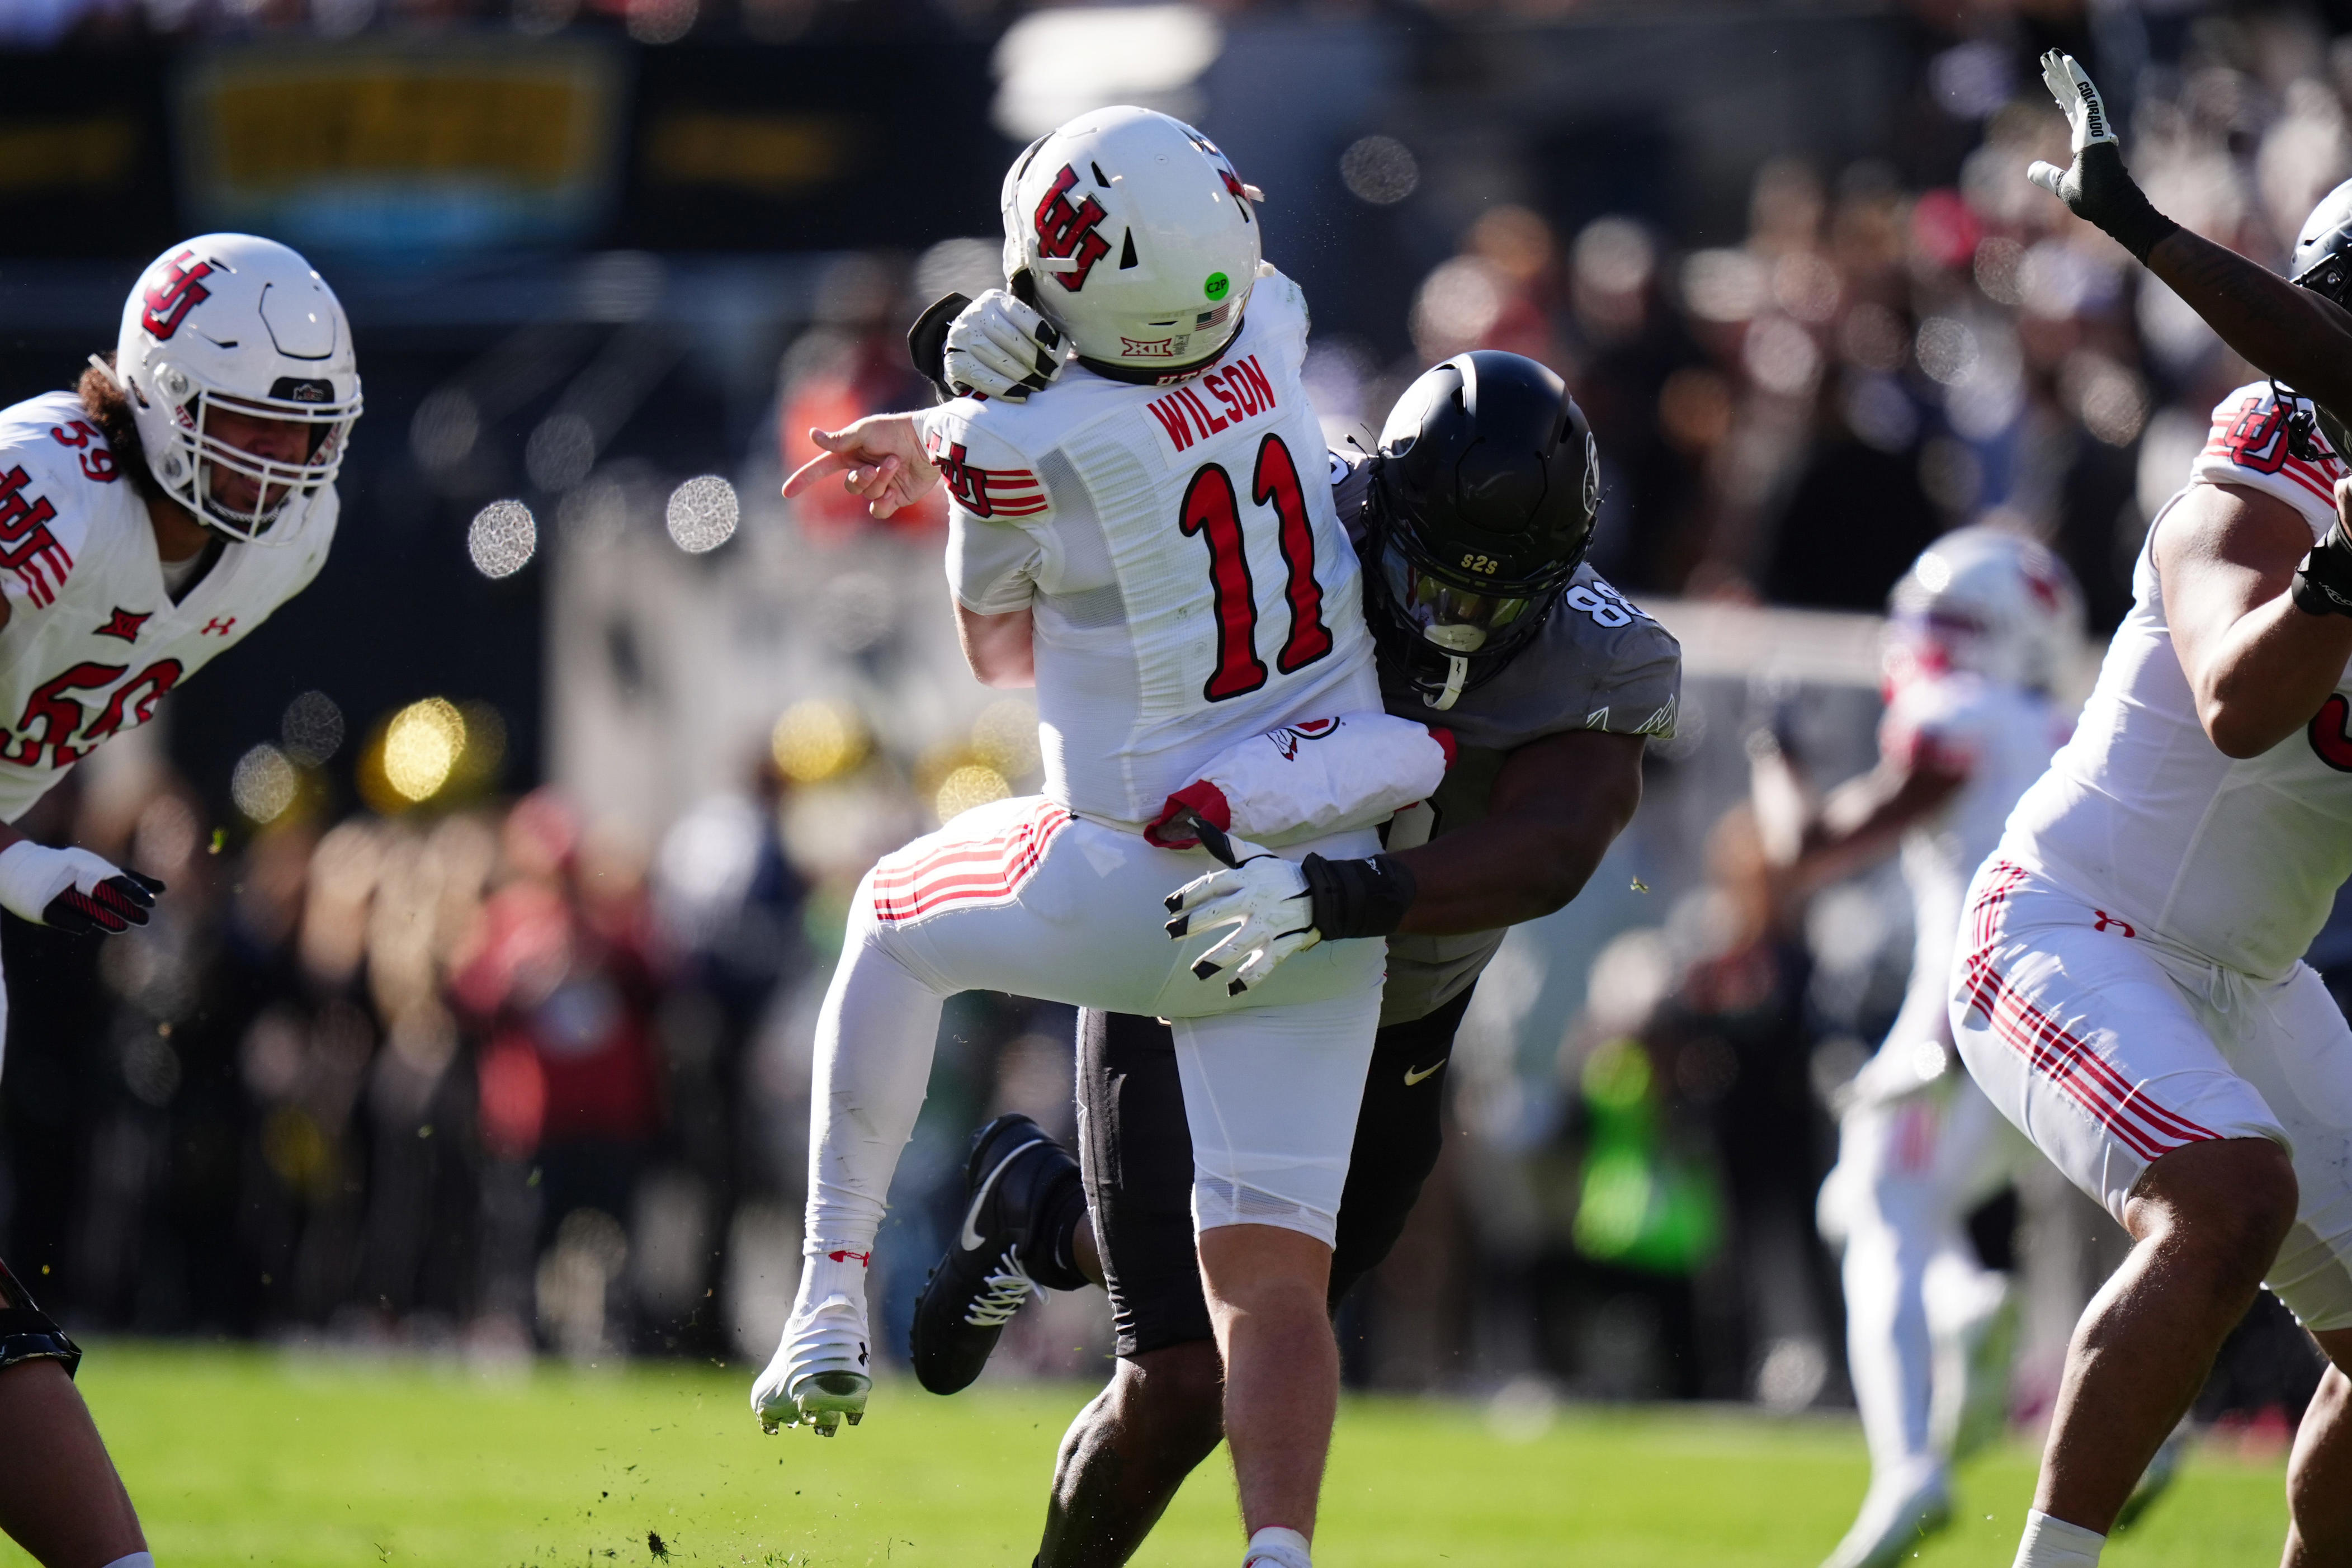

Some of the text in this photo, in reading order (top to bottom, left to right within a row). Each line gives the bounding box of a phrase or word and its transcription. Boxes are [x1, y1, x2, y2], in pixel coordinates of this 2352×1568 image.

[2077, 81, 2104, 137] COLORADO
[1207, 278, 1227, 293] C2P
[1146, 354, 1276, 452] WILSON
[50, 421, 120, 483] 59
[1179, 433, 1333, 702] 11
